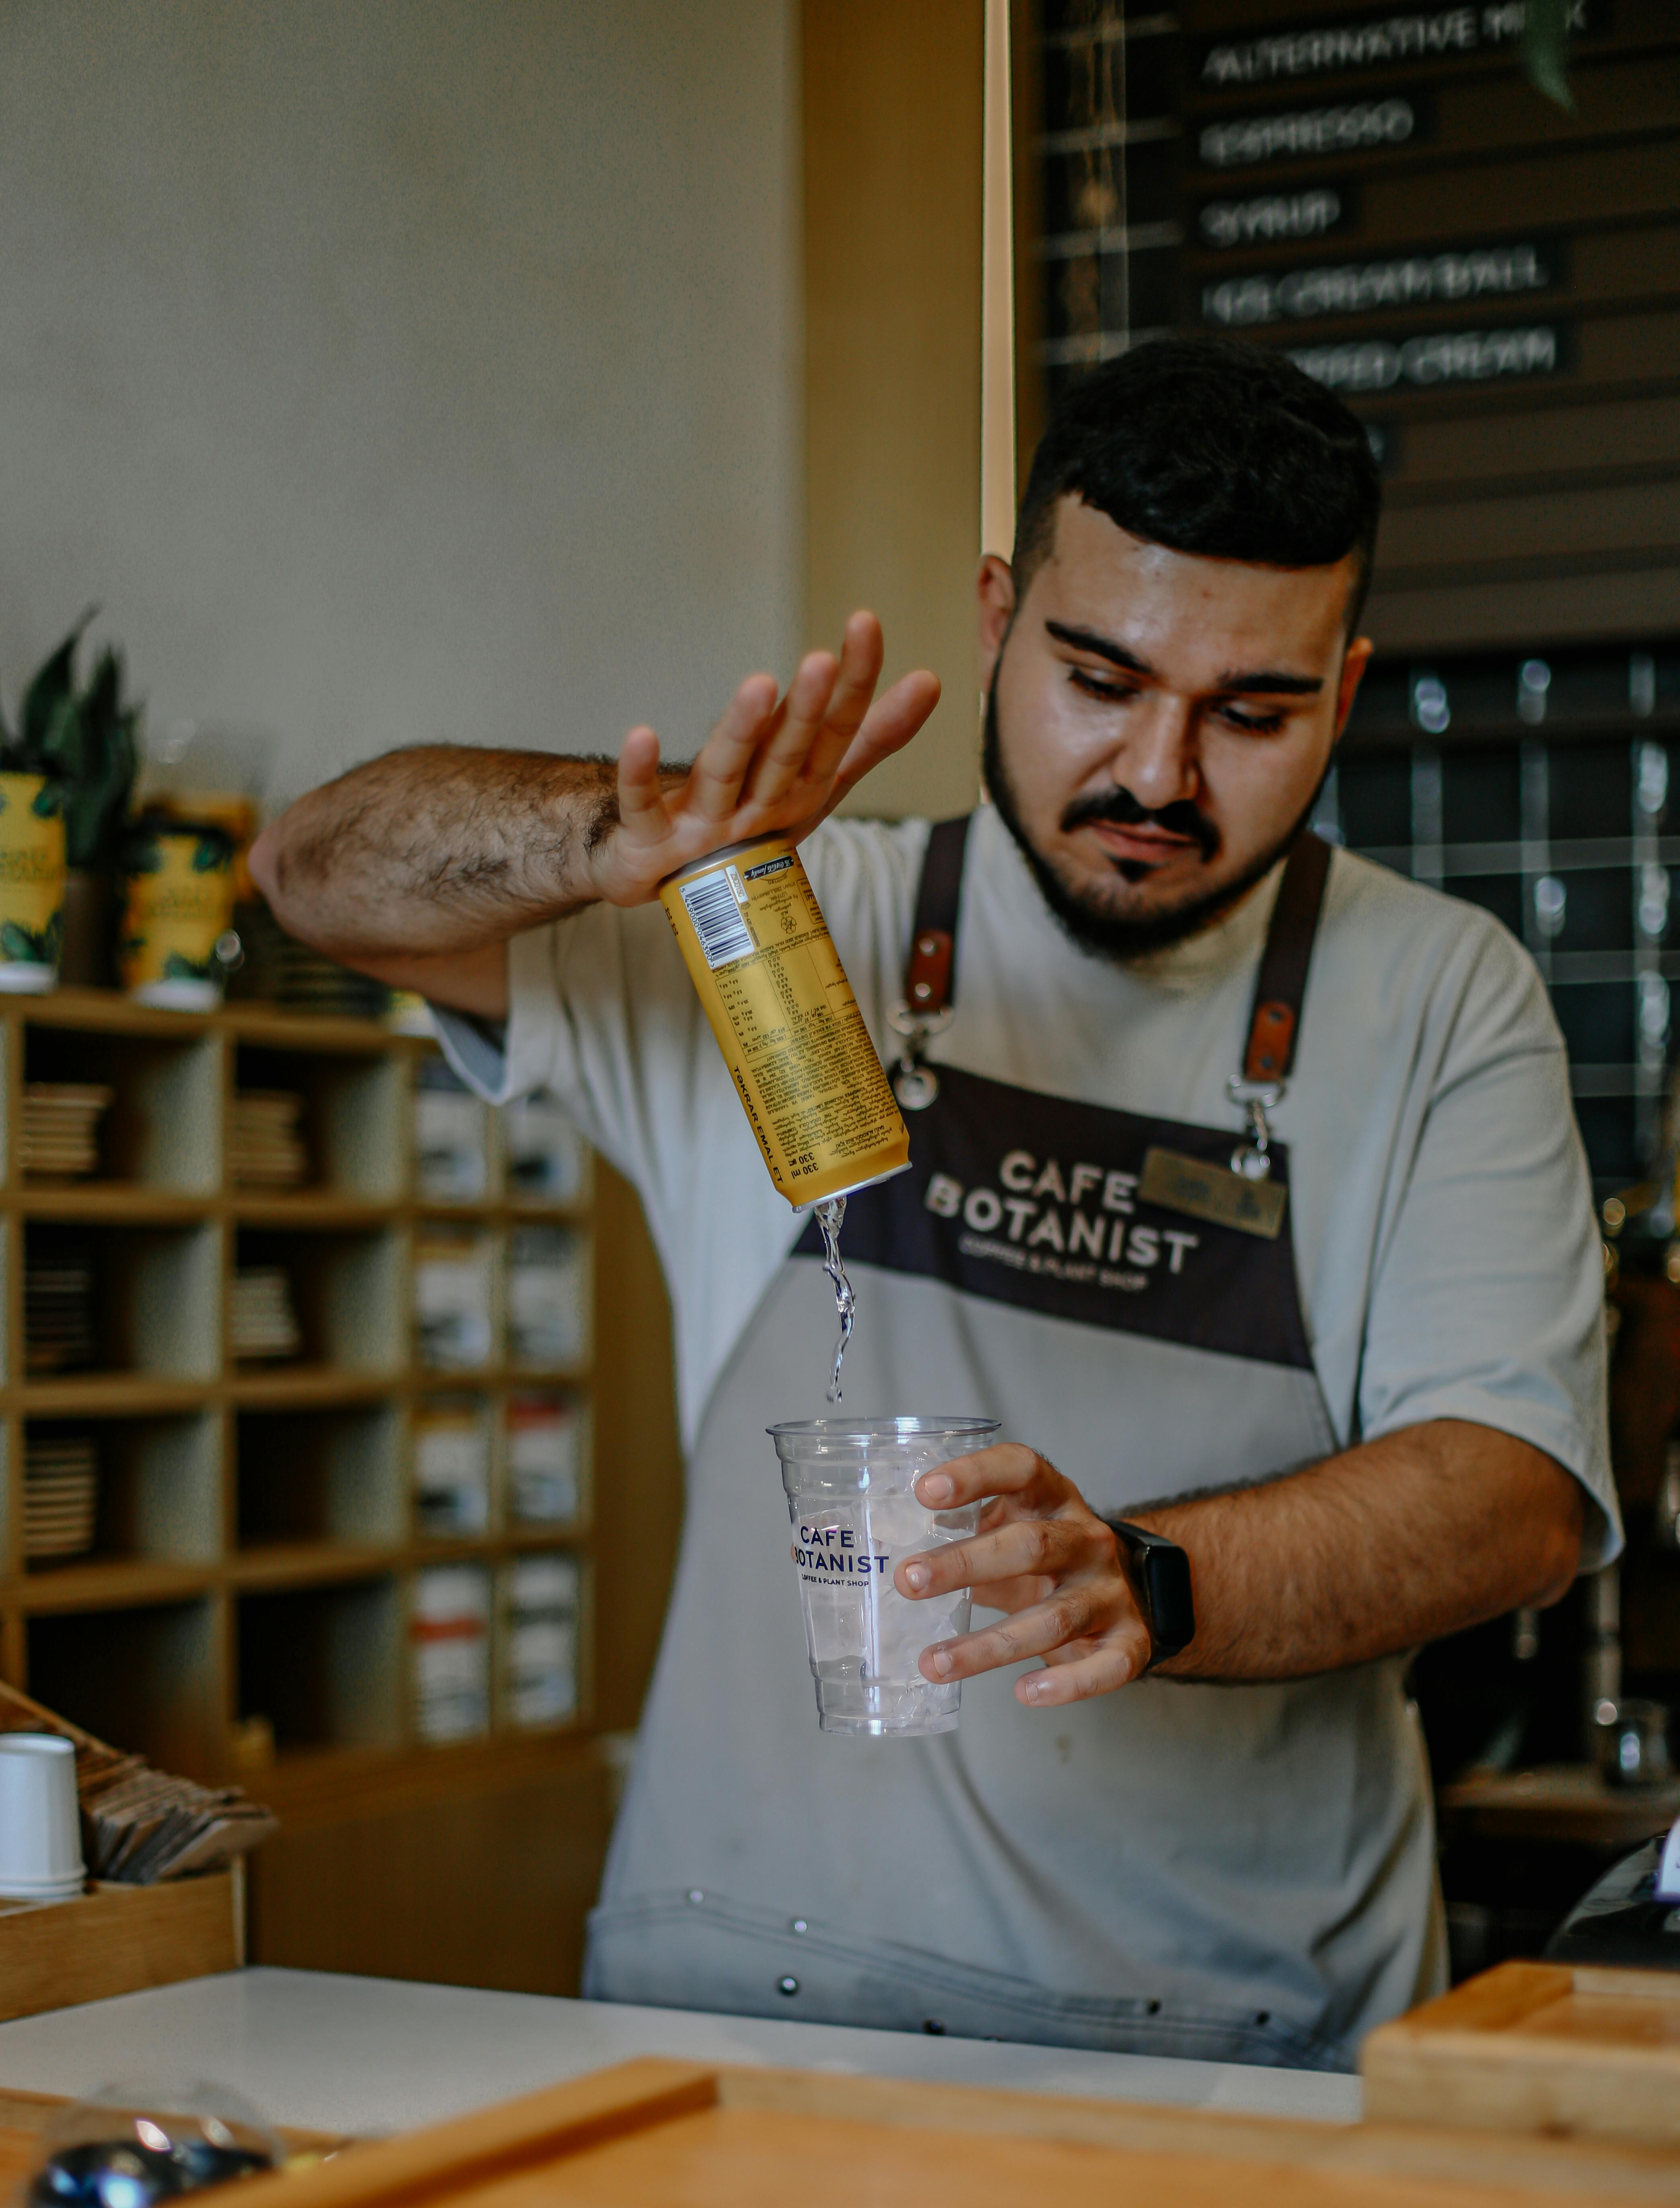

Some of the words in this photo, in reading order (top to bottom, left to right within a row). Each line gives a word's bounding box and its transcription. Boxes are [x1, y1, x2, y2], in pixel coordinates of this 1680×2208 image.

[1202, 6, 1478, 83] ALTERNATIVE
[1482, 0, 1586, 42] MK
[1200, 99, 1413, 165] ESPRESSO
[1201, 189, 1340, 246] SYRUP
[1276, 259, 1431, 317] CREAM
[1429, 244, 1549, 299] BALL
[1400, 327, 1556, 383] CREAM
[749, 864, 769, 879] family
[684, 897, 700, 928] 449000
[696, 930, 712, 961] 046390
[733, 1065, 759, 1123] TƏKRAR
[756, 1125, 775, 1164] EMAL
[772, 1166, 783, 1184] ET
[791, 1169, 802, 1179] ml
[798, 1151, 815, 1164] 330
[802, 1162, 819, 1175] 330
[999, 1149, 1141, 1214] CAFE
[926, 1173, 1199, 1274] BOTANIST
[794, 1547, 889, 1574] BOTANIST
[801, 1526, 854, 1548] CAFE
[823, 1578, 845, 1586] PLANT
